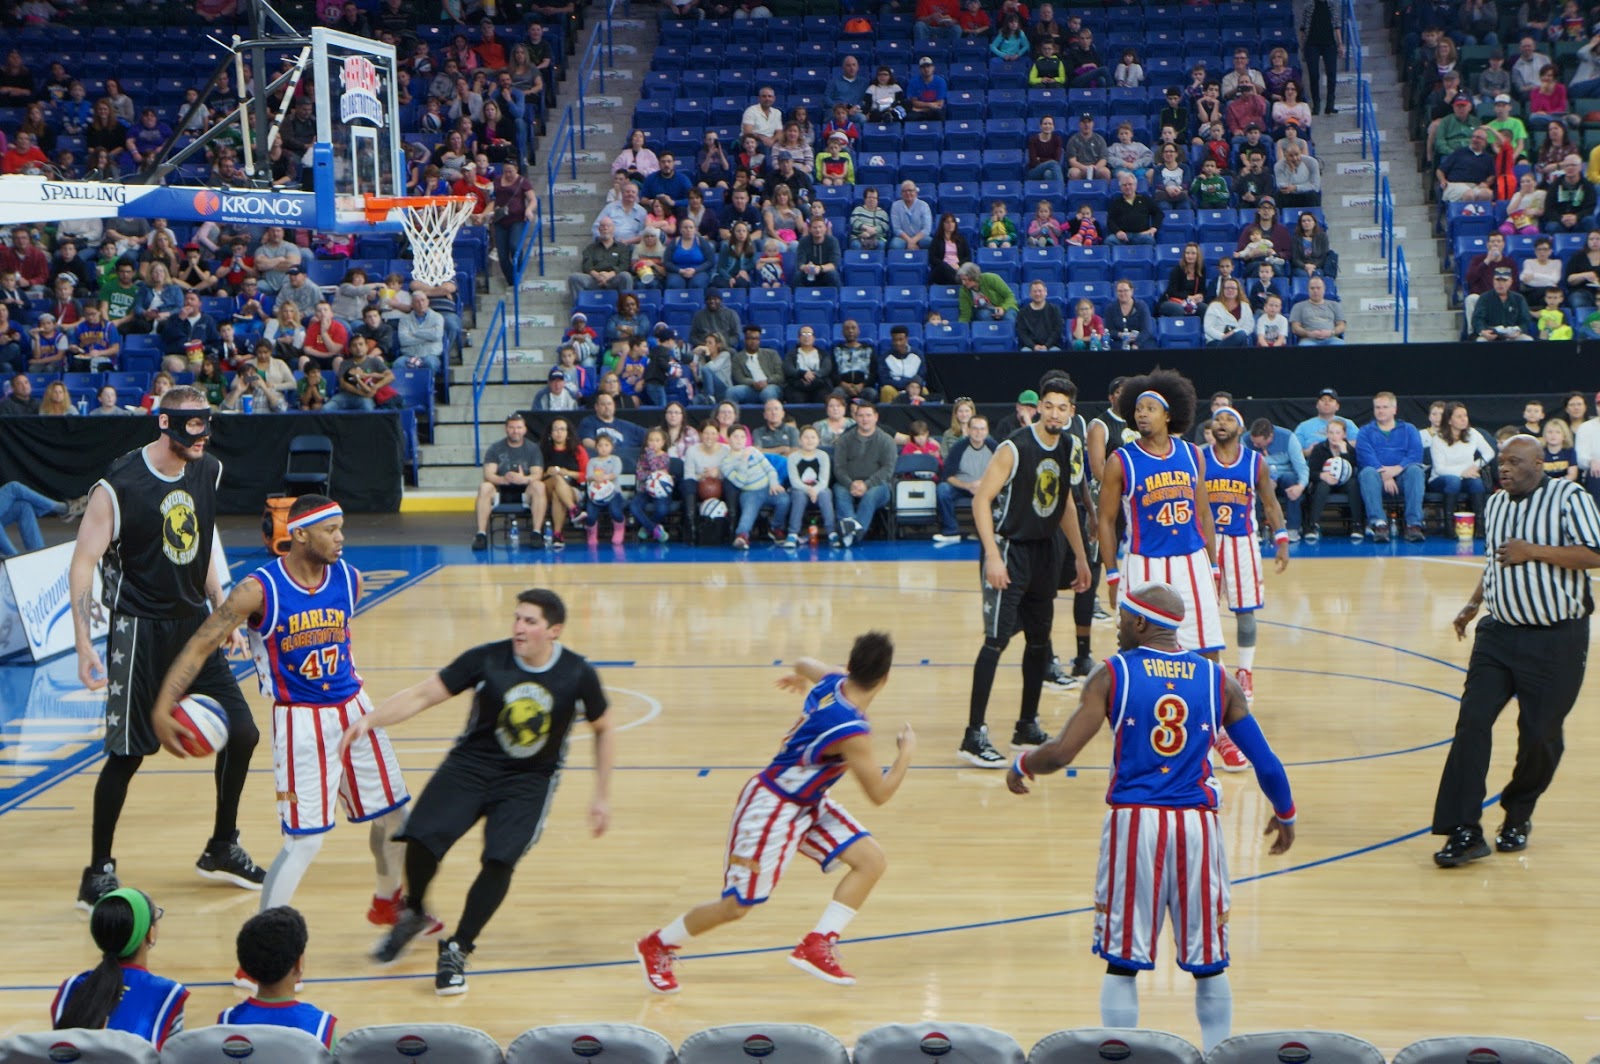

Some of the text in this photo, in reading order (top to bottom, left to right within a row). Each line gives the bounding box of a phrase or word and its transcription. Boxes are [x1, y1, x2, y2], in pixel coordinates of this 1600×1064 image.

[222, 196, 302, 216] KRONOS
[1145, 471, 1192, 492] HARLEM
[1205, 479, 1247, 494] HARLEM
[160, 489, 195, 517] WORLD
[1156, 500, 1191, 526] 45
[1215, 505, 1233, 525] 2
[288, 608, 345, 635] HARLEM
[299, 644, 339, 680] 47
[1142, 658, 1197, 680] FIREFLY
[1150, 693, 1189, 757] 3
